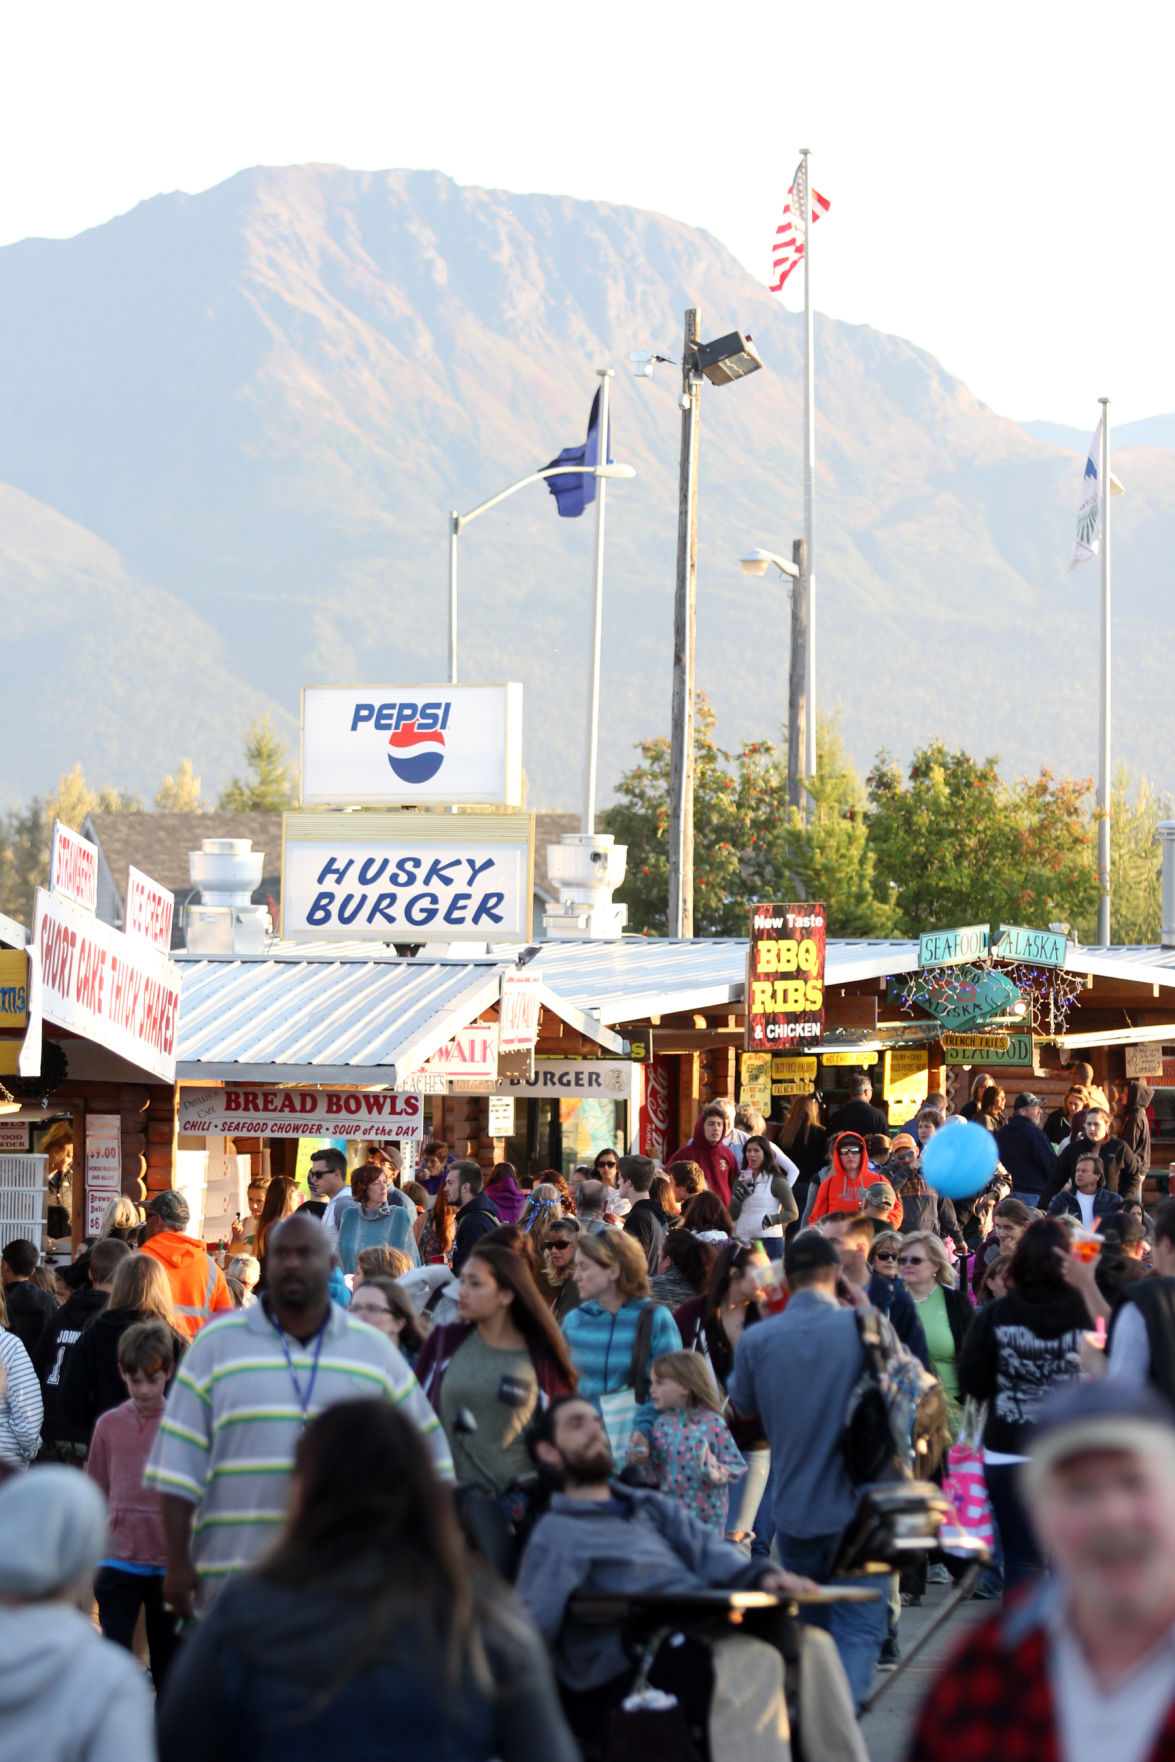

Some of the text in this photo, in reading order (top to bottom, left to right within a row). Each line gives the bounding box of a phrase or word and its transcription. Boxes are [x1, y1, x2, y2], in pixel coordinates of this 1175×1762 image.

[350, 702, 451, 732] PEPSI
[316, 856, 495, 888] HUSKY
[129, 879, 174, 949] ICE CREAM
[306, 891, 505, 926] BURGER
[754, 913, 823, 929] New Taste
[756, 938, 819, 977] BBQ
[924, 930, 987, 962] SEAFOOD
[1003, 928, 1060, 961] ALASKA
[40, 913, 179, 1056] SHORT CAKE THICK SHAKES
[751, 979, 823, 1014] RIBS
[0, 986, 25, 1014] ms
[754, 1022, 821, 1039] & CHICKEN
[945, 1035, 1006, 1049] FRENCH FRIES
[398, 1074, 445, 1093] EACHES
[224, 1091, 420, 1115] BREAD BOWLS
[183, 1120, 418, 1137] CHILI SEAFOOD CHOWDER SOUP of the DAY
[90, 1147, 116, 1159] $9.00
